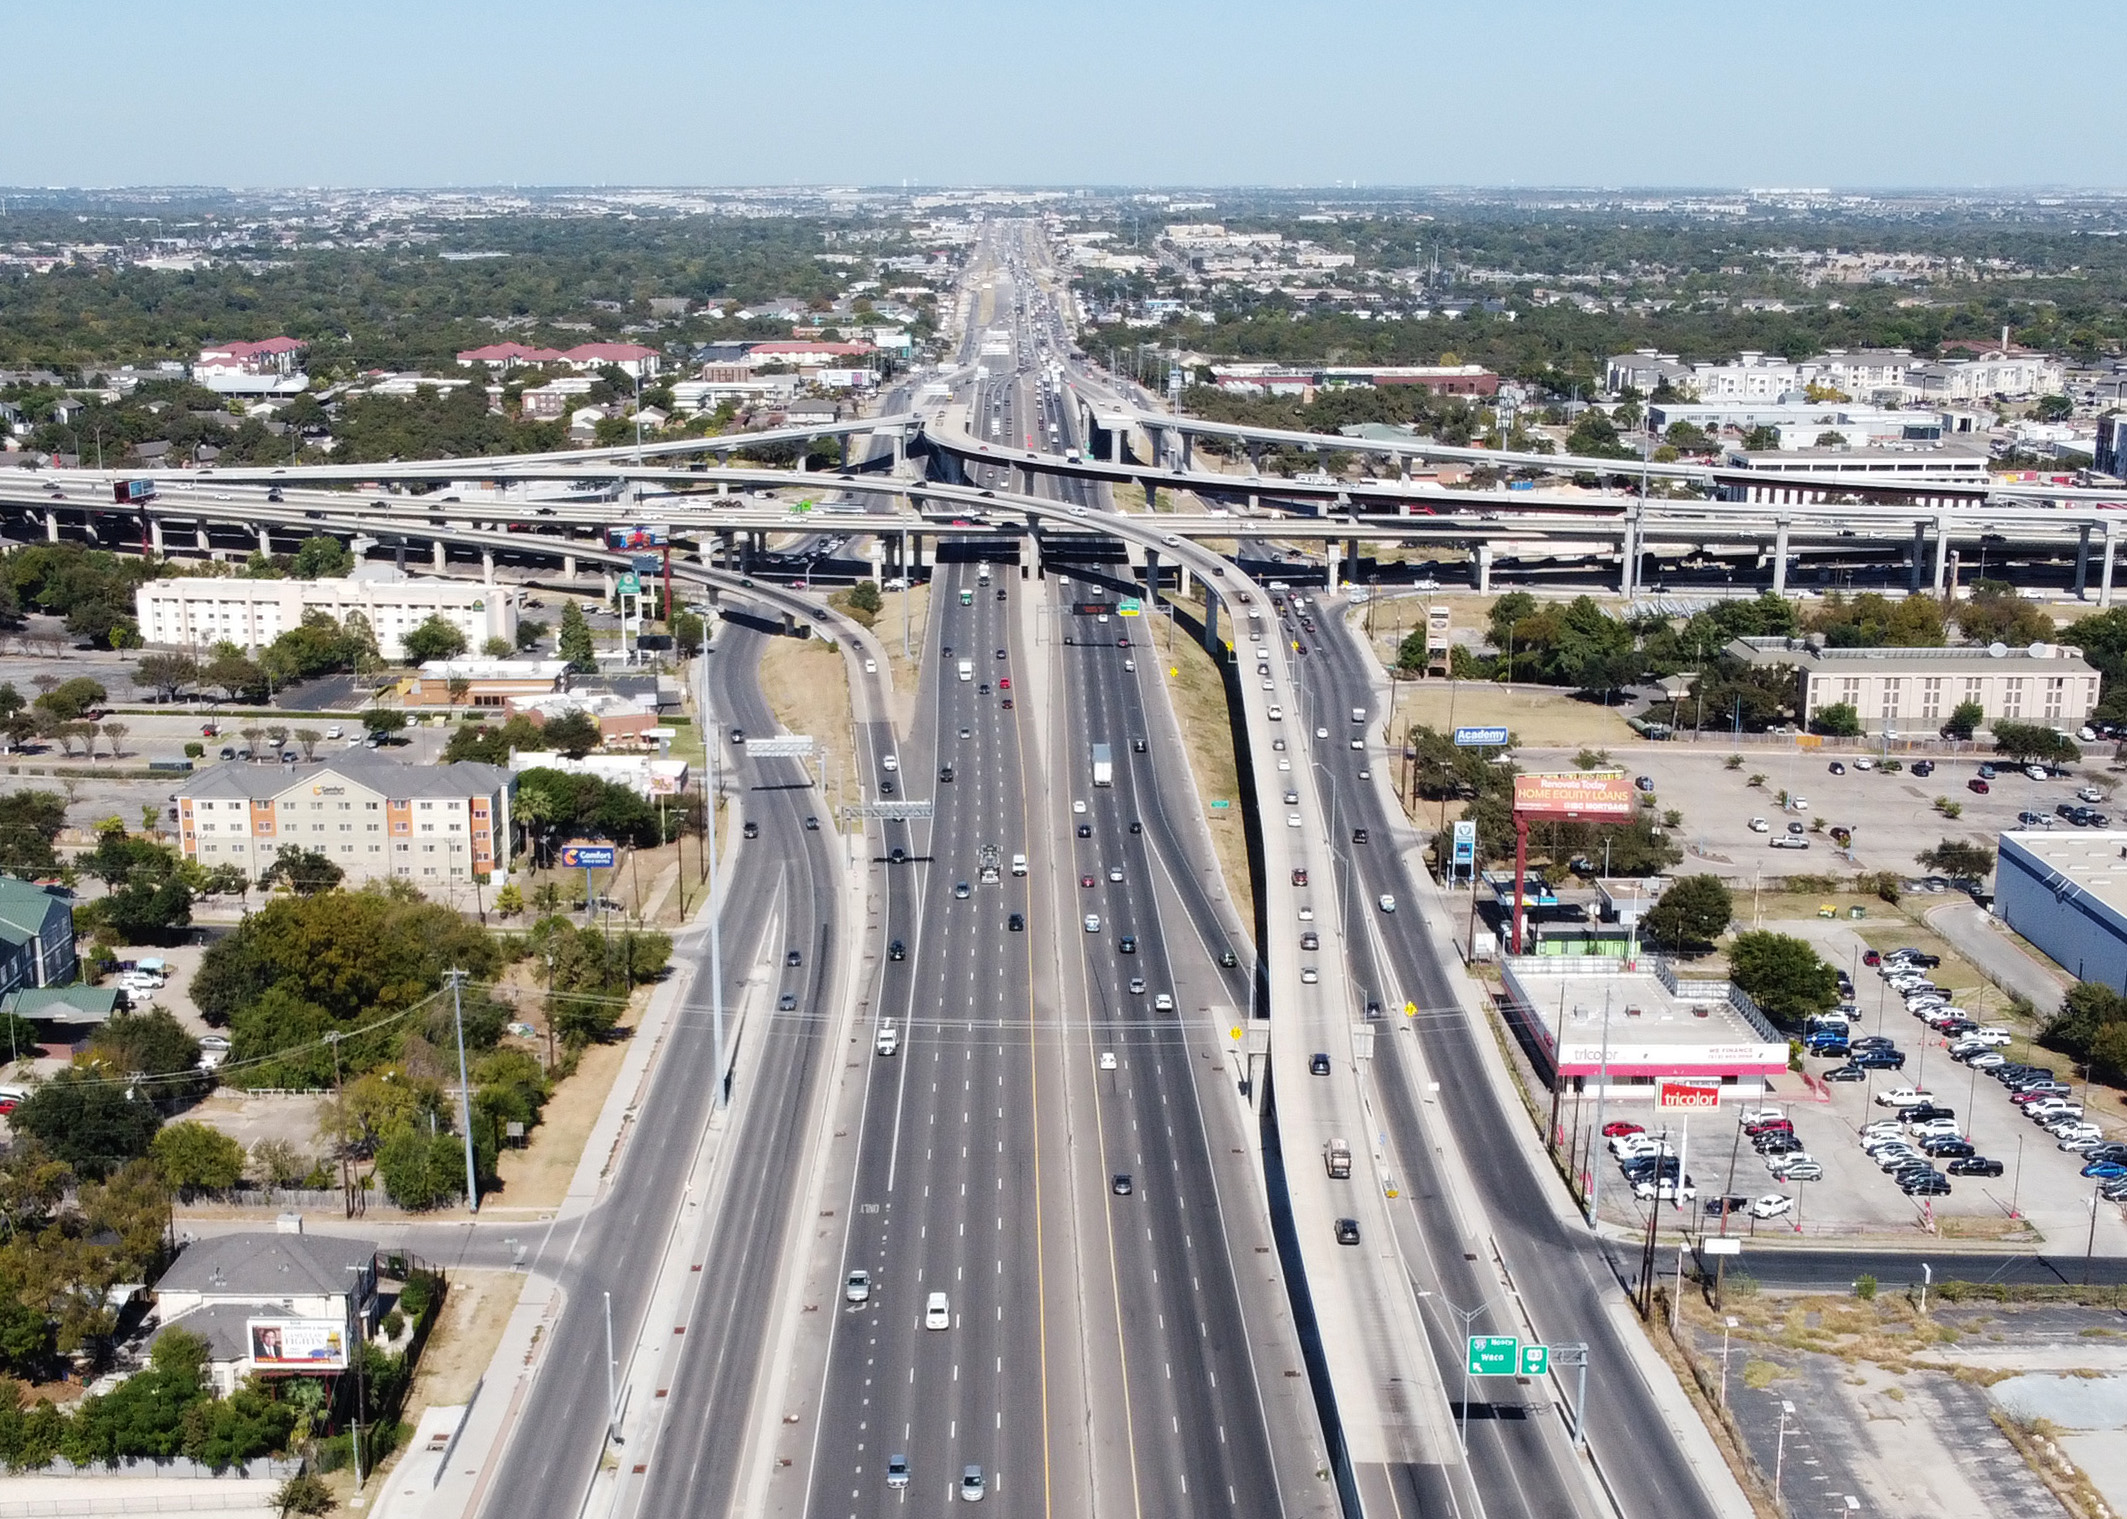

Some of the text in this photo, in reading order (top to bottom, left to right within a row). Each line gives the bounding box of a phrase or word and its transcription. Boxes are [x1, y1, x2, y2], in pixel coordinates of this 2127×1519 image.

[1458, 730, 1505, 741] Academy
[1540, 779, 1608, 791] Renovate Today
[1518, 789, 1629, 801] HOME EQUITY LOANS
[580, 851, 611, 859] Comfort
[1574, 1049, 1618, 1060] tricoor
[1664, 1090, 1716, 1106] tricolor
